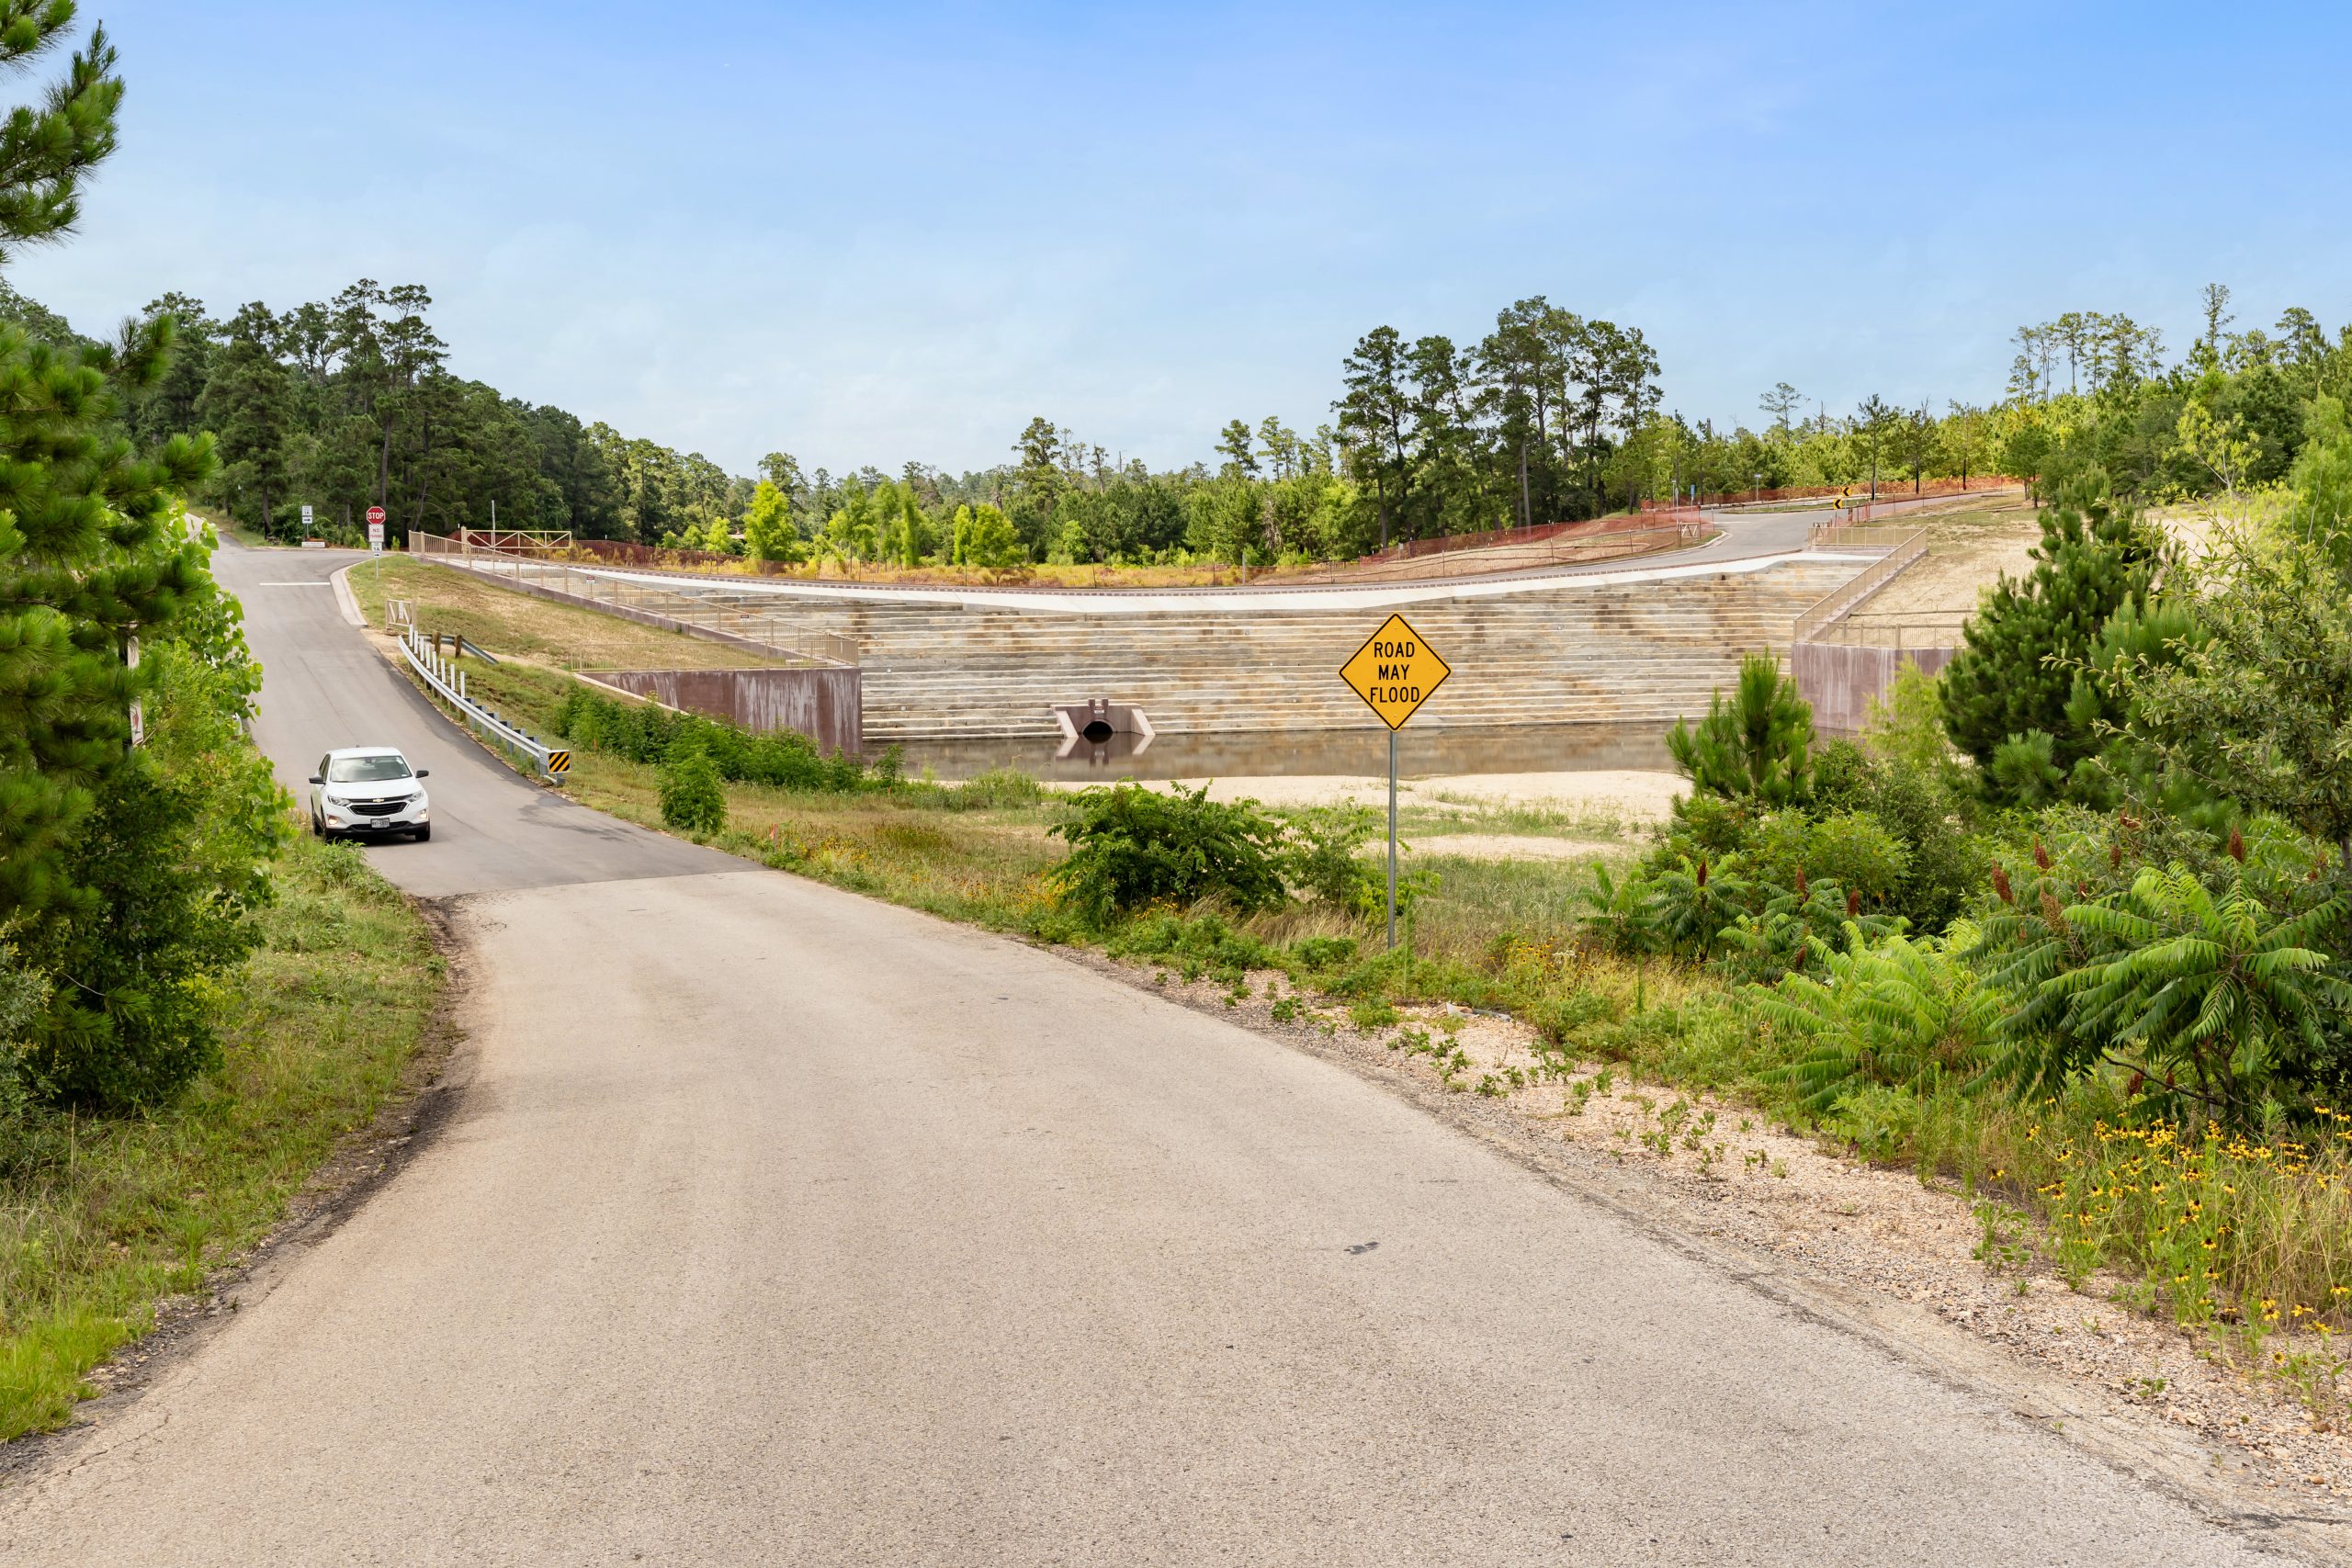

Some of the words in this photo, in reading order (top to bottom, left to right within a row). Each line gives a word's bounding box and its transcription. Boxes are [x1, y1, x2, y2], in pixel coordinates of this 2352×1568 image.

[1374, 642, 1415, 658] ROAD
[1378, 664, 1409, 680] MAY
[1370, 687, 1419, 703] FLOOD
